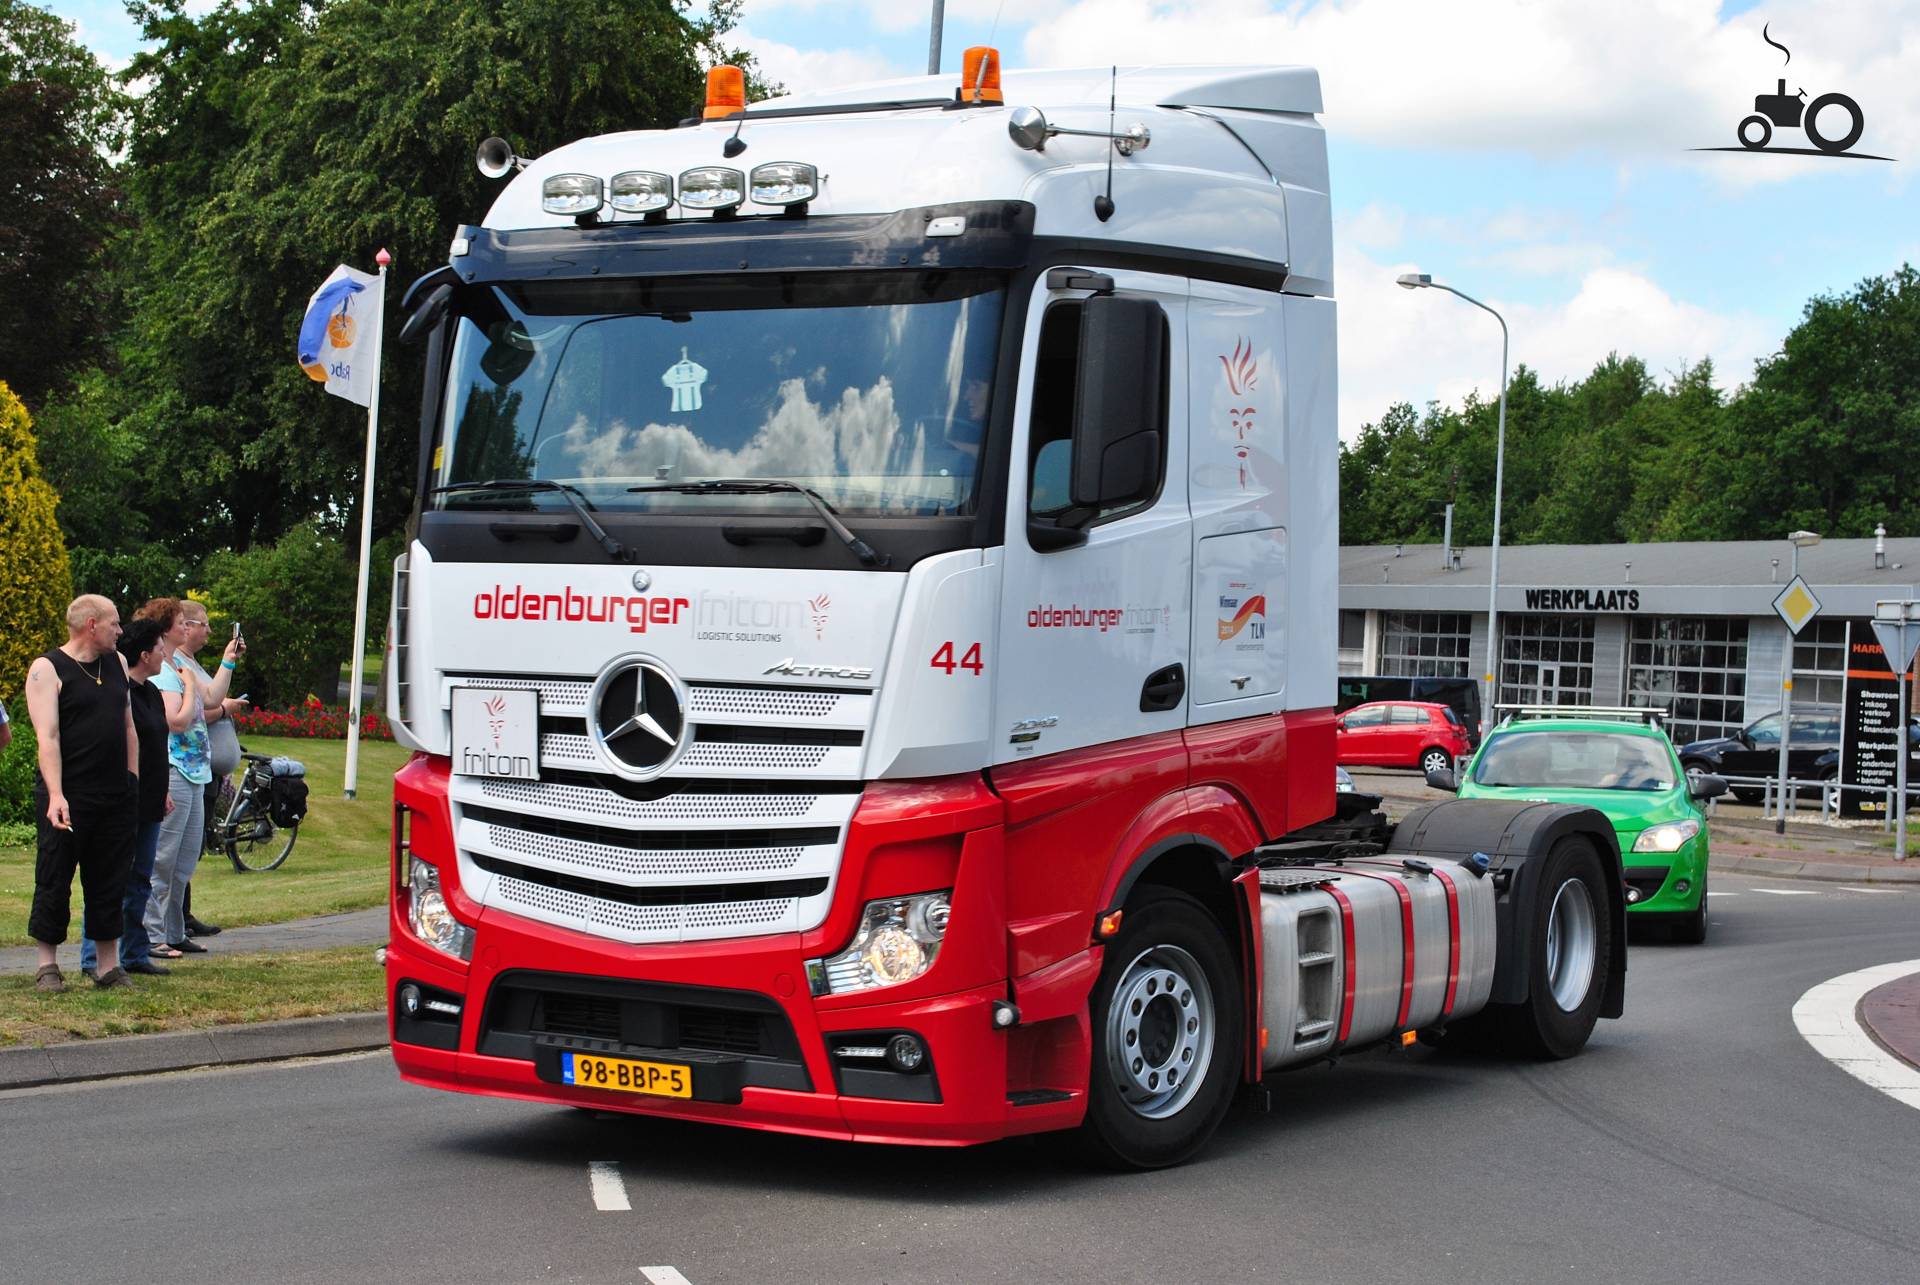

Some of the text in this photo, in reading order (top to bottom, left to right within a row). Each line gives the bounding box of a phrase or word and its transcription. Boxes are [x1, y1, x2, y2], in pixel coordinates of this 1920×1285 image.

[1525, 589, 1640, 611] WERKPLAATS
[474, 584, 805, 634] oldenburger fritom
[1027, 603, 1124, 633] oldenburger
[697, 631, 782, 643] LOGISTIC SOLUTIONS
[1852, 643, 1883, 654] HARR
[931, 640, 984, 677] 44
[1860, 690, 1899, 699] Showroom
[1864, 700, 1888, 709] inkoop
[1863, 709, 1891, 717] verkoop
[1863, 717, 1882, 725] lease
[1861, 752, 1875, 760] apk
[464, 746, 531, 777] fritom
[1861, 760, 1896, 768] onderhoud
[1861, 769, 1893, 777] reparaties
[1860, 776, 1886, 784] banden
[580, 1058, 685, 1093] 98-BBP-5
